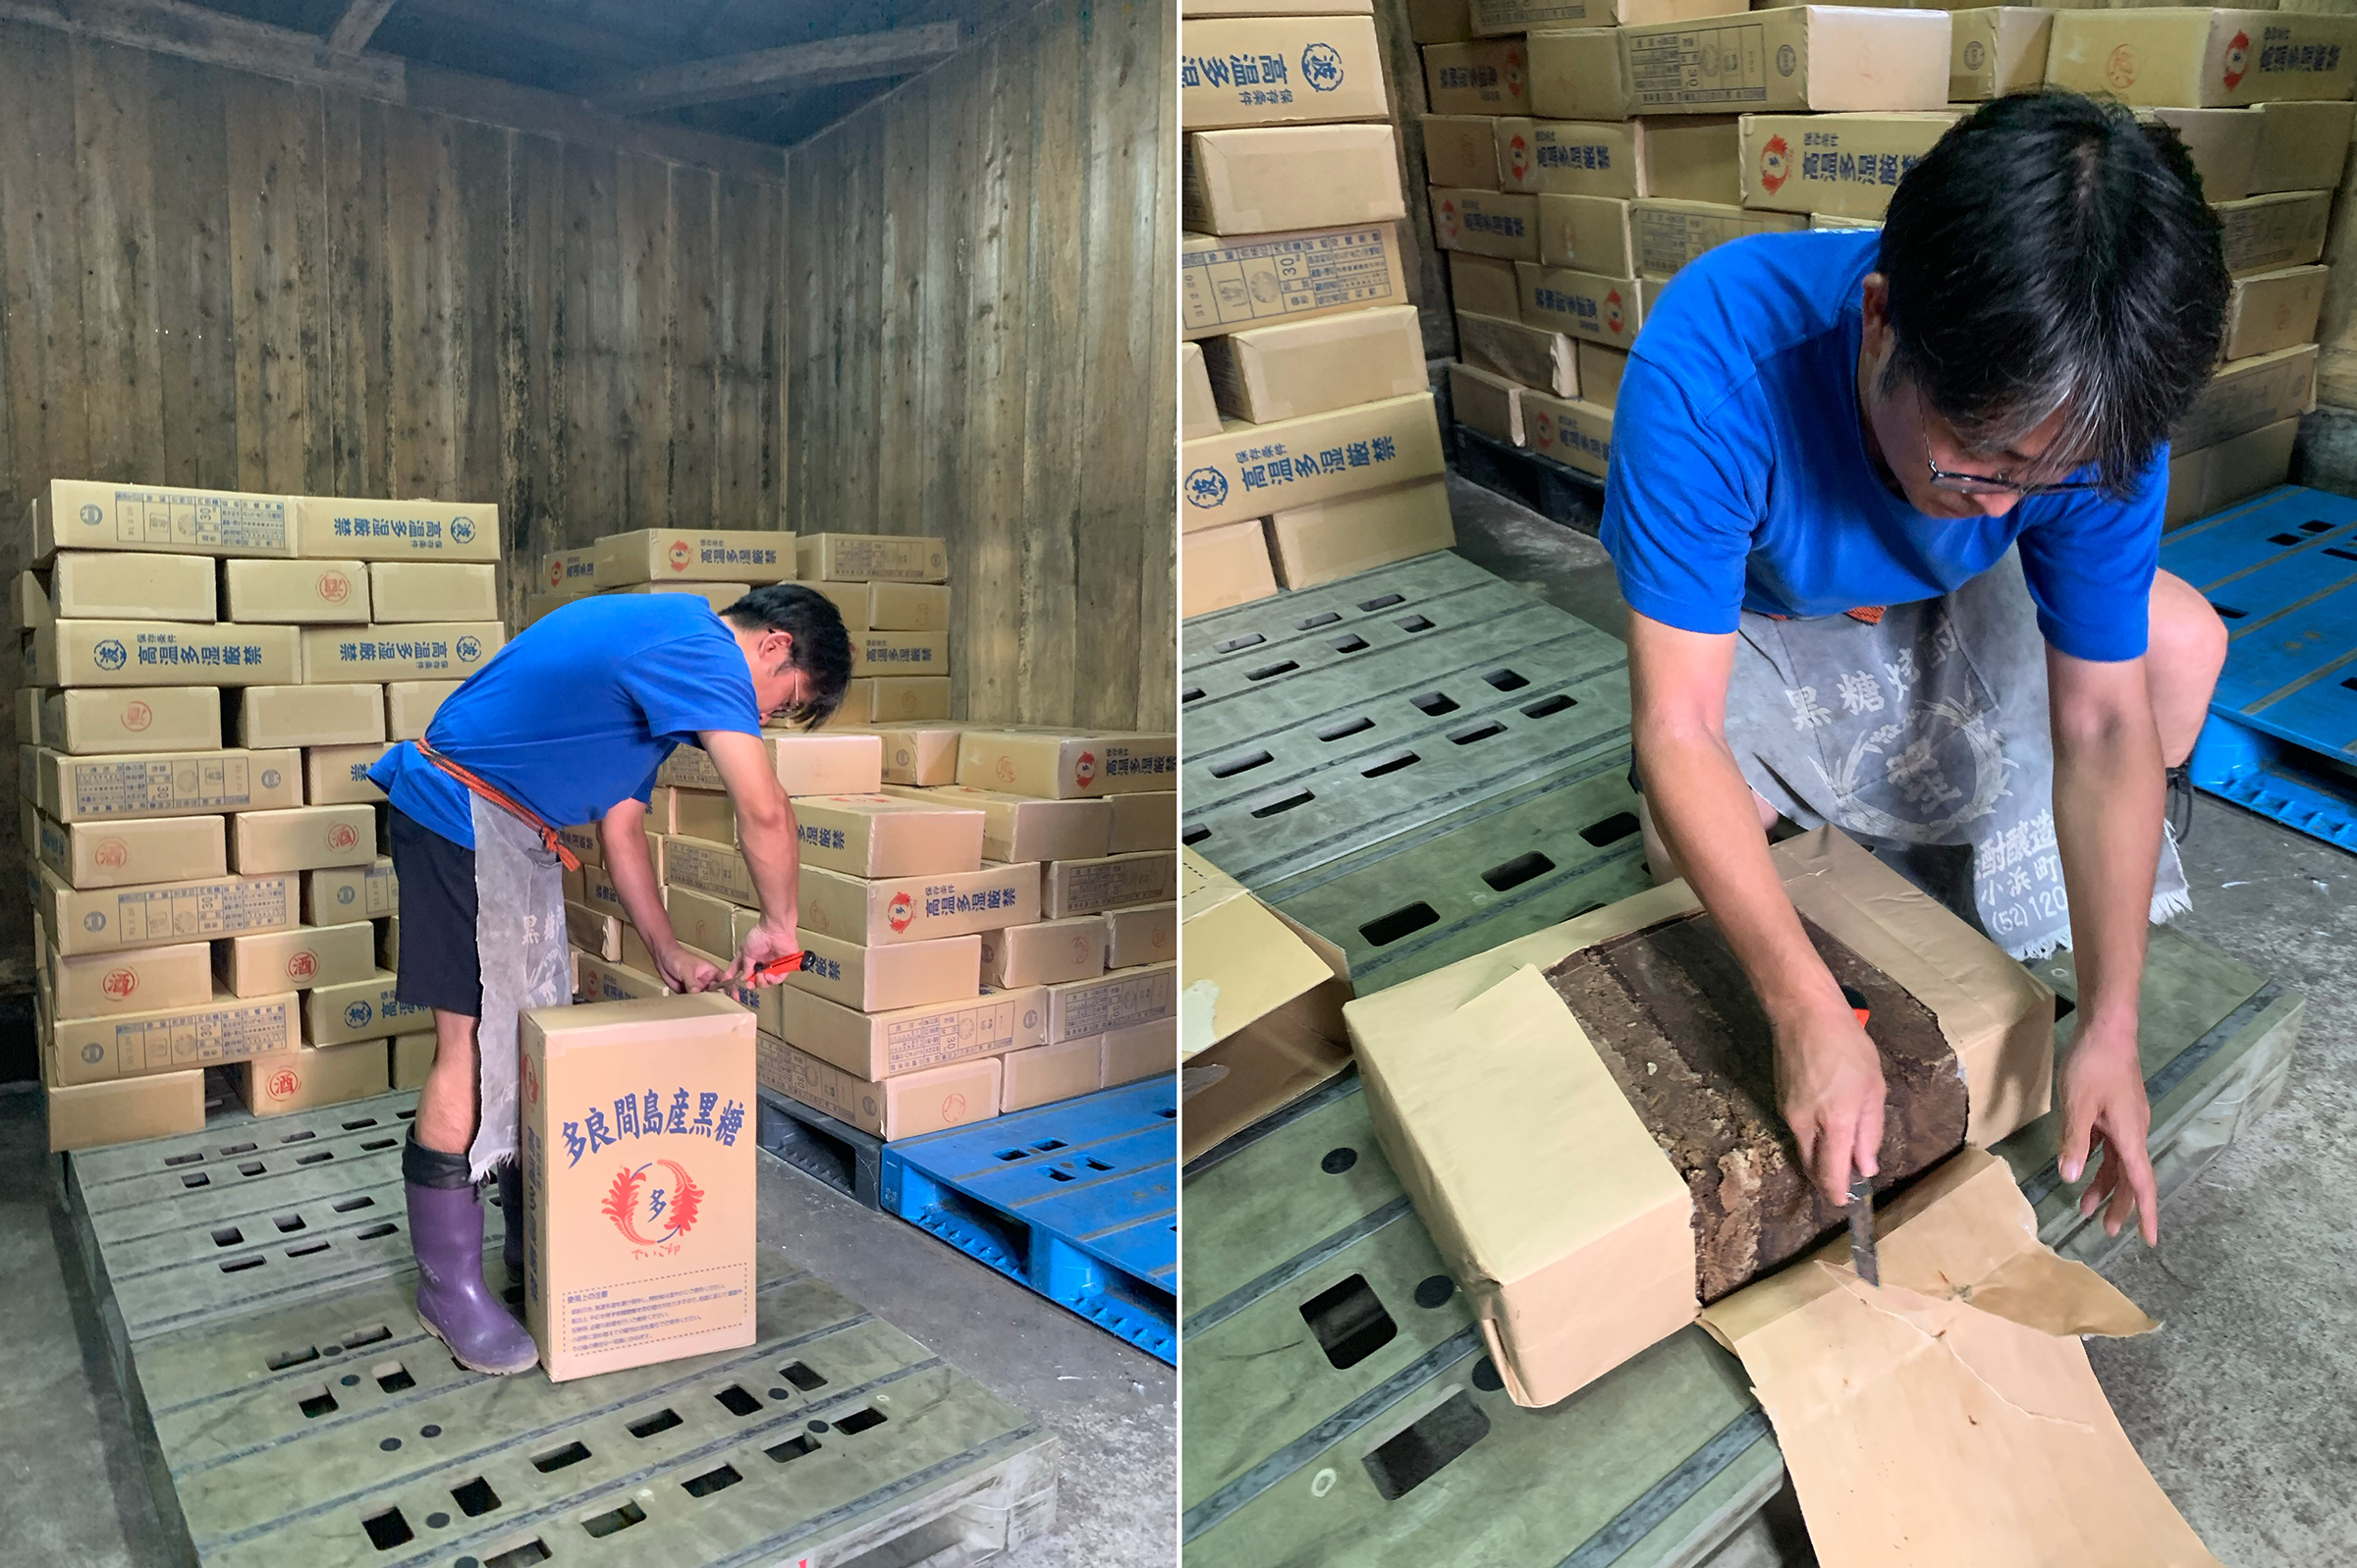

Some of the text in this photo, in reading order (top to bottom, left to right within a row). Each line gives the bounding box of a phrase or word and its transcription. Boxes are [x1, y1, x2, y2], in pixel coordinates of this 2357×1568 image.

[1282, 257, 1297, 276] 30
[1241, 436, 1397, 492] 高温多湿厳禁
[334, 517, 442, 538] 高温多湿厳禁
[138, 646, 262, 666] 高温多湿厳禁
[340, 642, 448, 661] 高温多湿厳禁
[1981, 854, 2058, 906] 小浜町
[925, 888, 1016, 918] 高温多湿厳禁
[1992, 902, 2029, 935] (52)
[947, 1034, 957, 1050] 30
[561, 1087, 745, 1169] 多良間島産黒糖
[647, 1188, 668, 1223] 多
